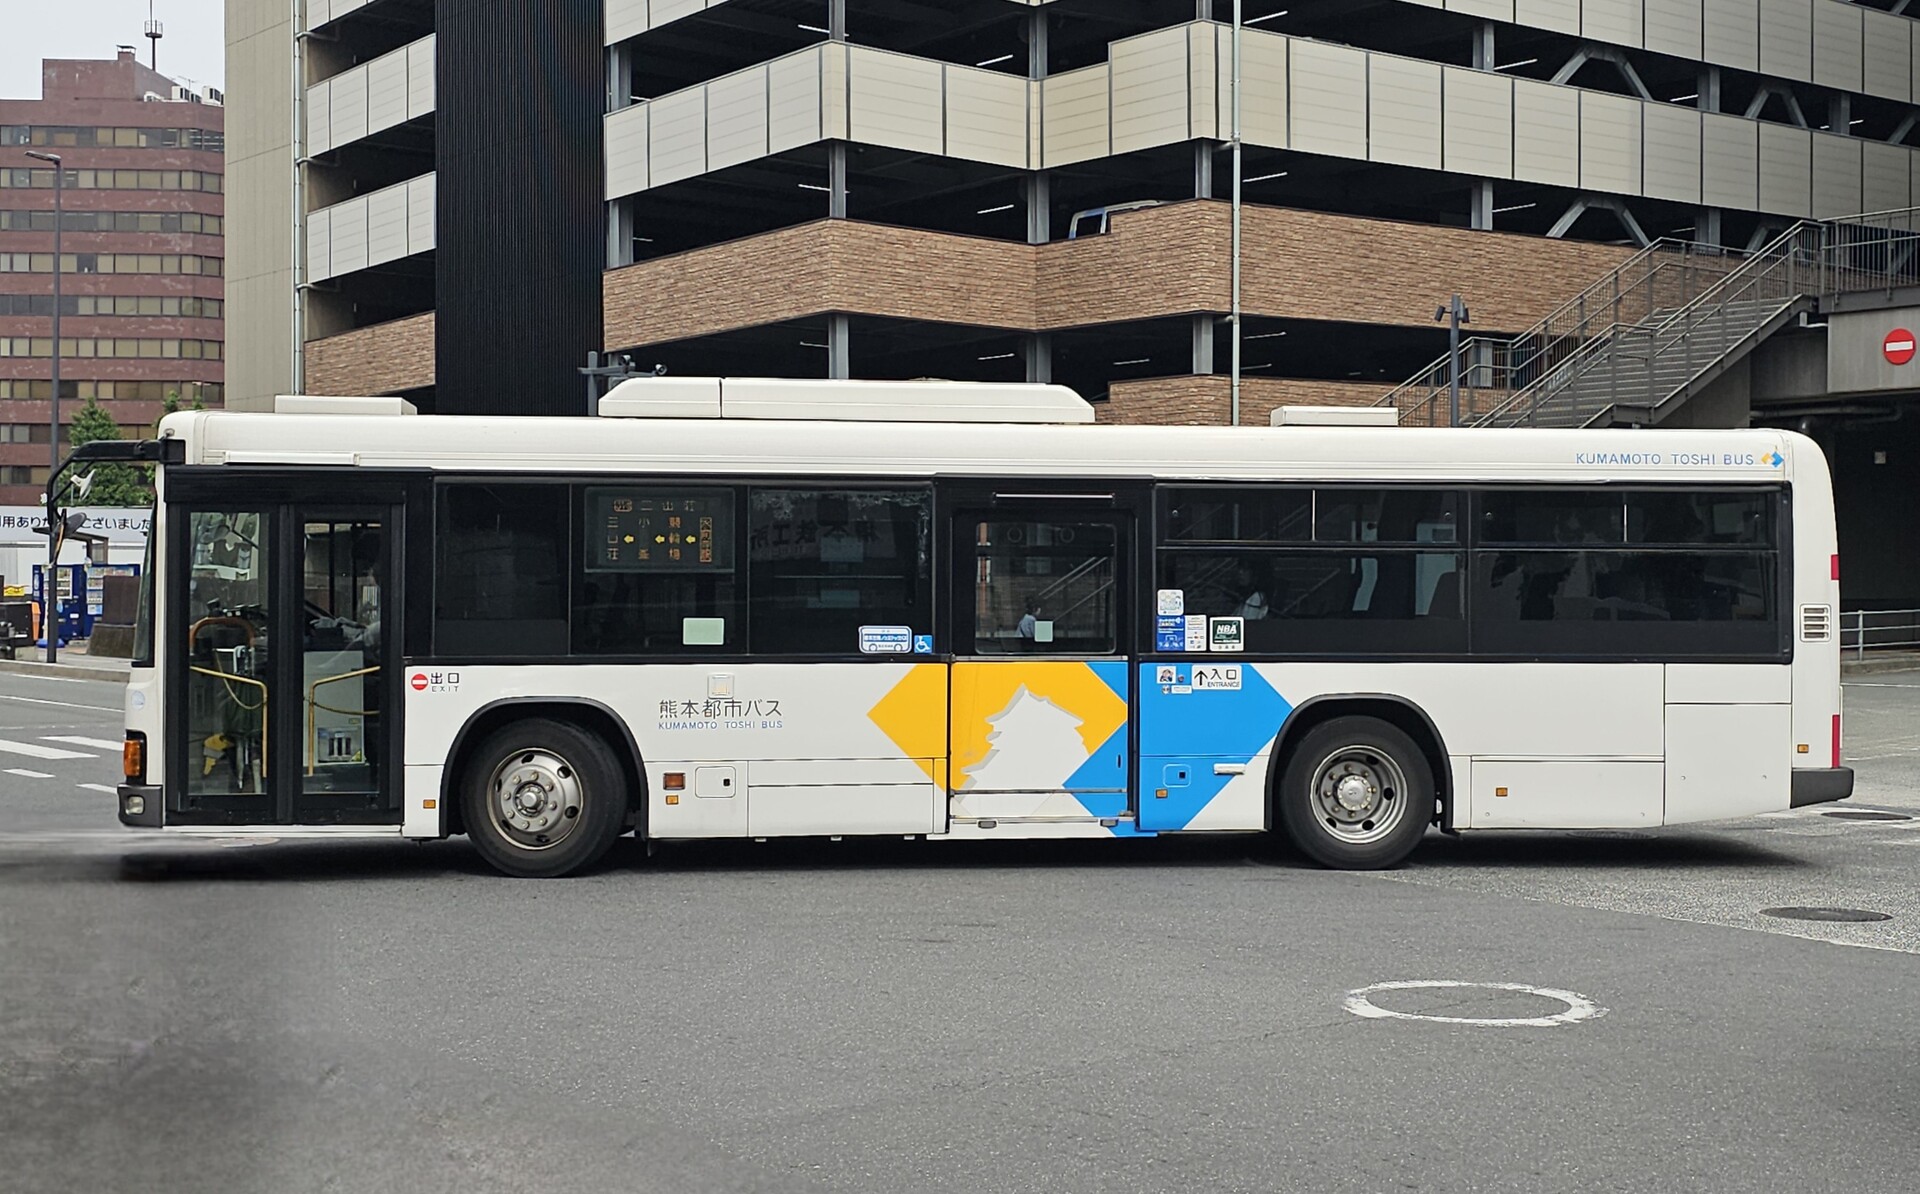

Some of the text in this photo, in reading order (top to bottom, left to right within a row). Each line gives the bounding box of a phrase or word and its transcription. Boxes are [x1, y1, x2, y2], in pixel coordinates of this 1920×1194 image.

[1576, 453, 1754, 466] KUMAMOTO TOSHI BUS
[430, 671, 460, 684] 出口
[1210, 668, 1237, 680] 入口
[659, 699, 782, 719] 熊本都市バス
[658, 720, 783, 730] KUMAMOTO TOSHI BUS
